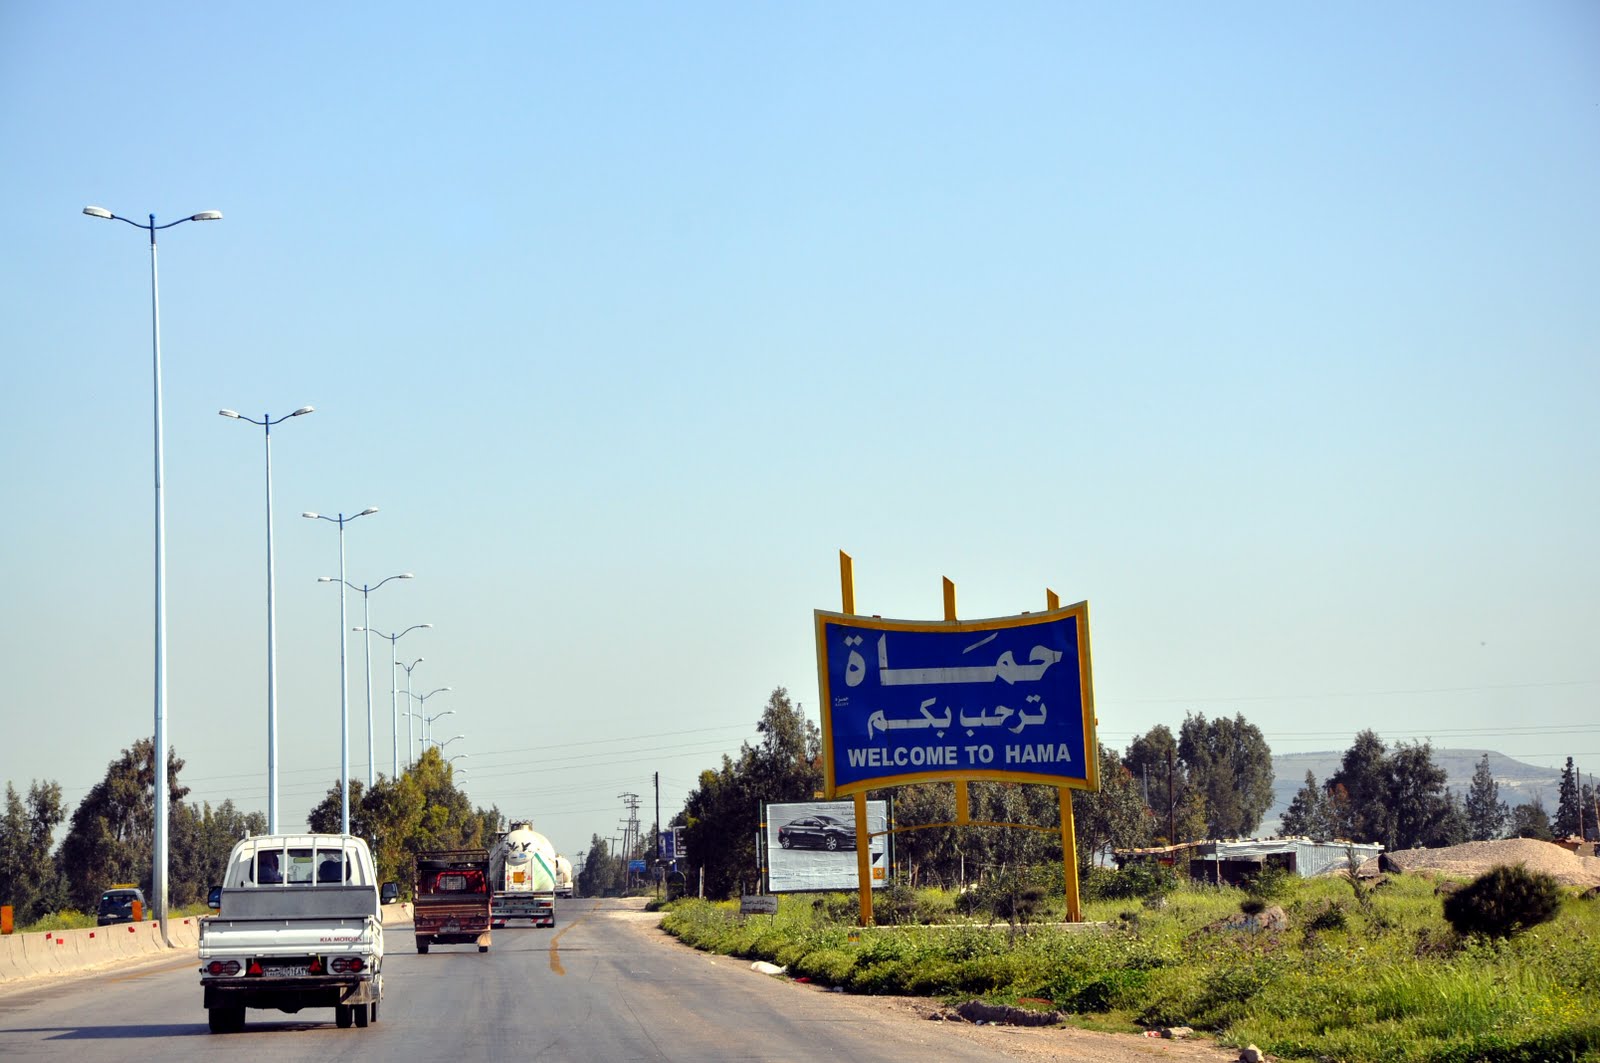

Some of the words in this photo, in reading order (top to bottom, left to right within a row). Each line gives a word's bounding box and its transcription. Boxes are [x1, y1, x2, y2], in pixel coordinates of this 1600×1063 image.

[867, 697, 952, 741] بكم
[959, 694, 1047, 737] ترحب
[847, 746, 958, 768] WELCOME
[964, 744, 994, 765] TO
[1005, 743, 1072, 763] HAMA
